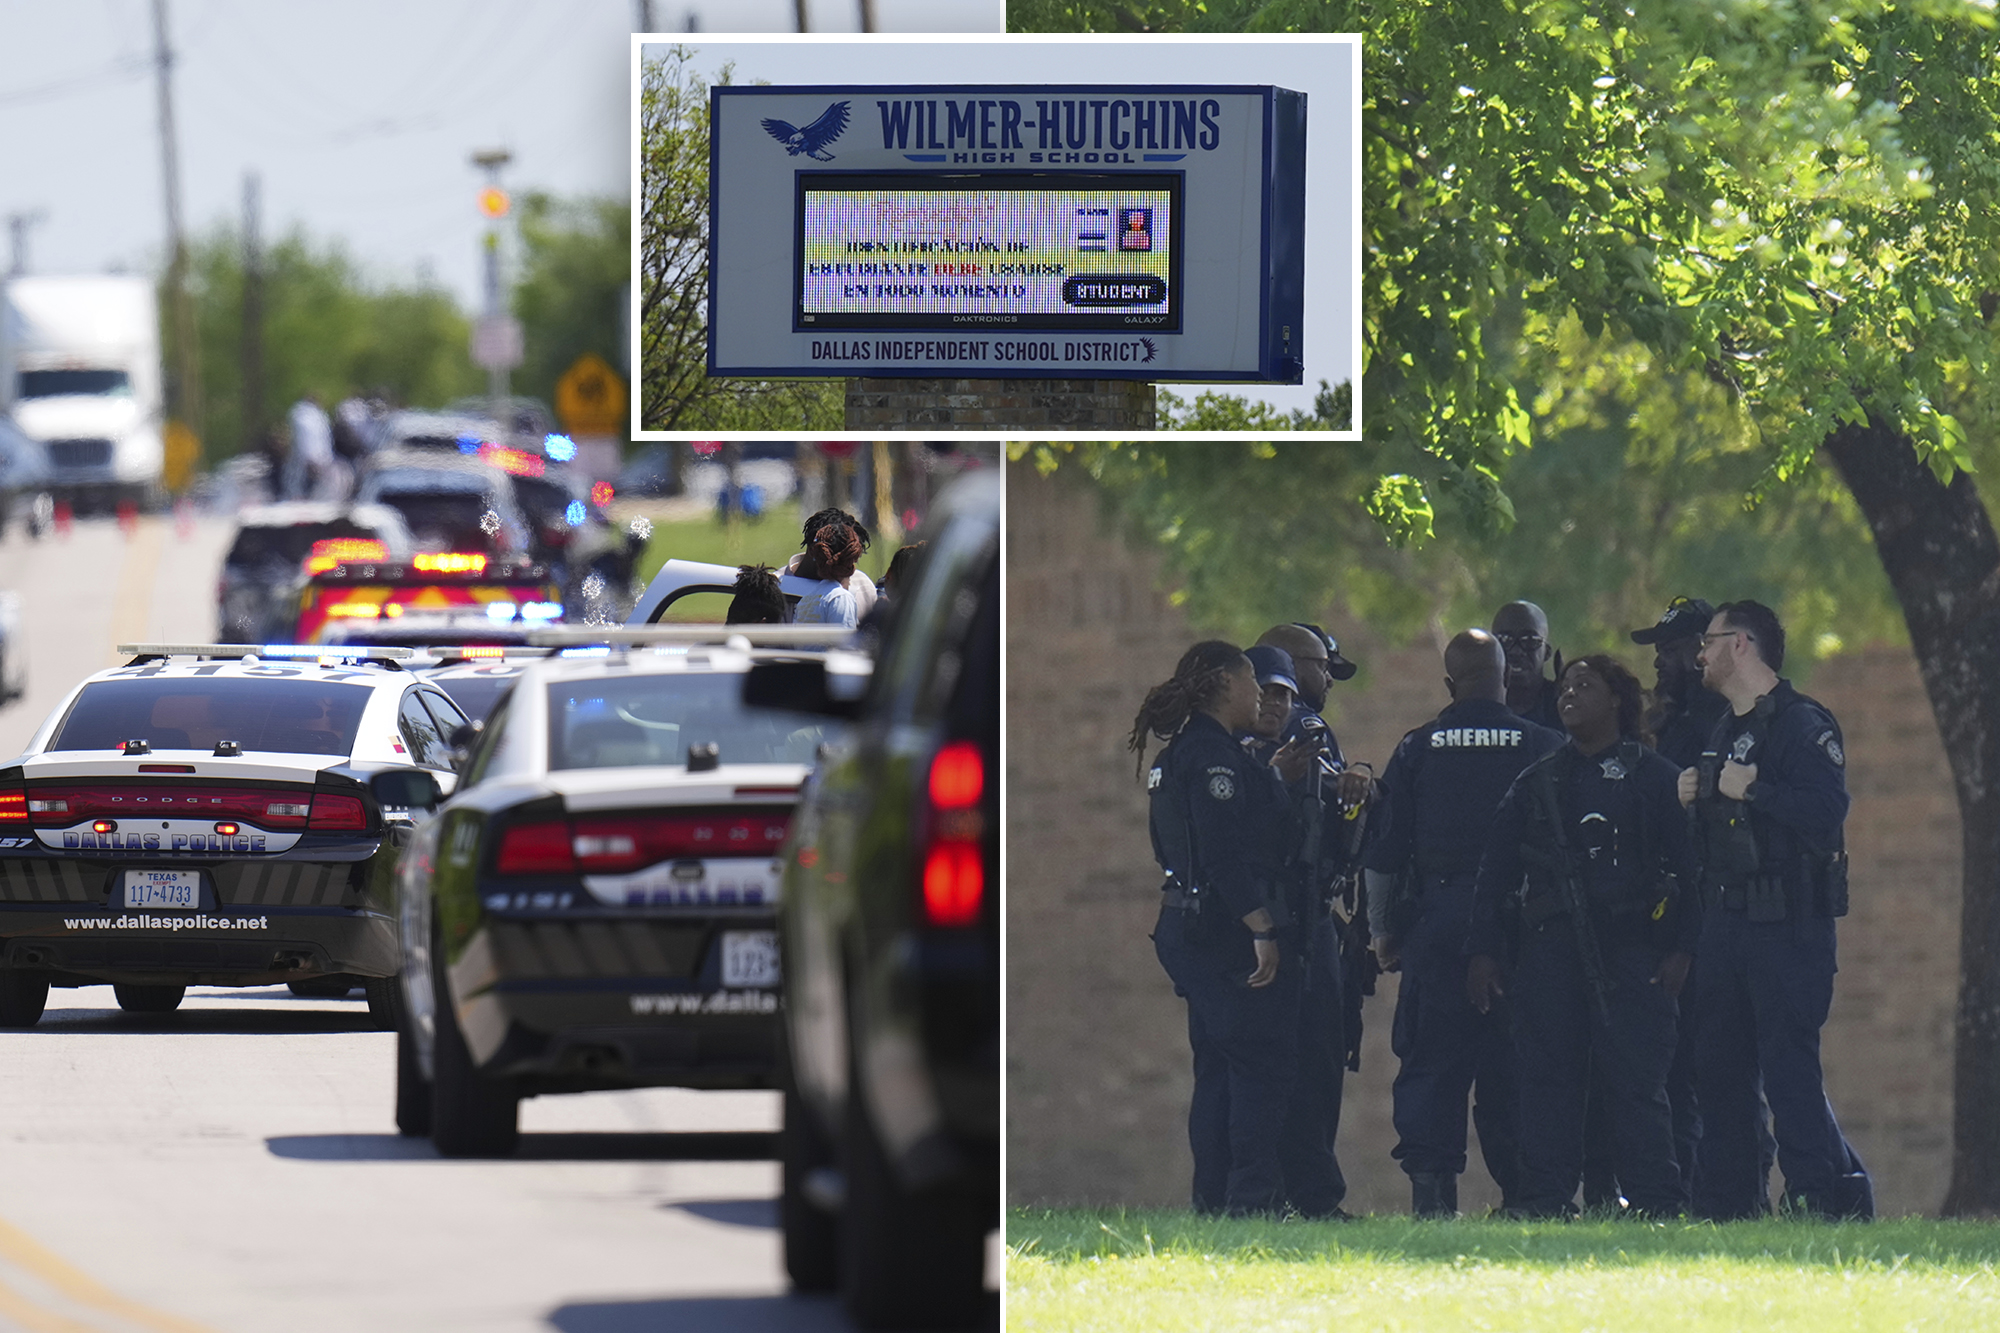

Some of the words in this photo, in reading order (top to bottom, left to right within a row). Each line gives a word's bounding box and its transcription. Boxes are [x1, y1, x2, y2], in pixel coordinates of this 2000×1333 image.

[877, 99, 1220, 151] WILMER-HUTCHINS
[953, 152, 1015, 163] HIGH
[1029, 152, 1135, 164] SCHOOL
[1077, 284, 1151, 299] STUDENT
[953, 315, 1018, 323] DAKTRONICS
[1124, 315, 1165, 324] GALAXY
[812, 341, 871, 361] DALLAS
[875, 341, 989, 361] INDEPENDENT
[994, 342, 1059, 362] SCHOOL
[1064, 342, 1140, 362] DISTRICT
[1431, 727, 1522, 748] SHERIFF
[112, 796, 222, 804] DODGE
[0, 837, 34, 848] 57
[63, 832, 161, 849] DALLAS
[171, 833, 266, 851] POLICE
[147, 873, 178, 881] TEXAS
[64, 915, 268, 931] www.dallaspolice.net
[631, 990, 784, 1014] www.dalla
